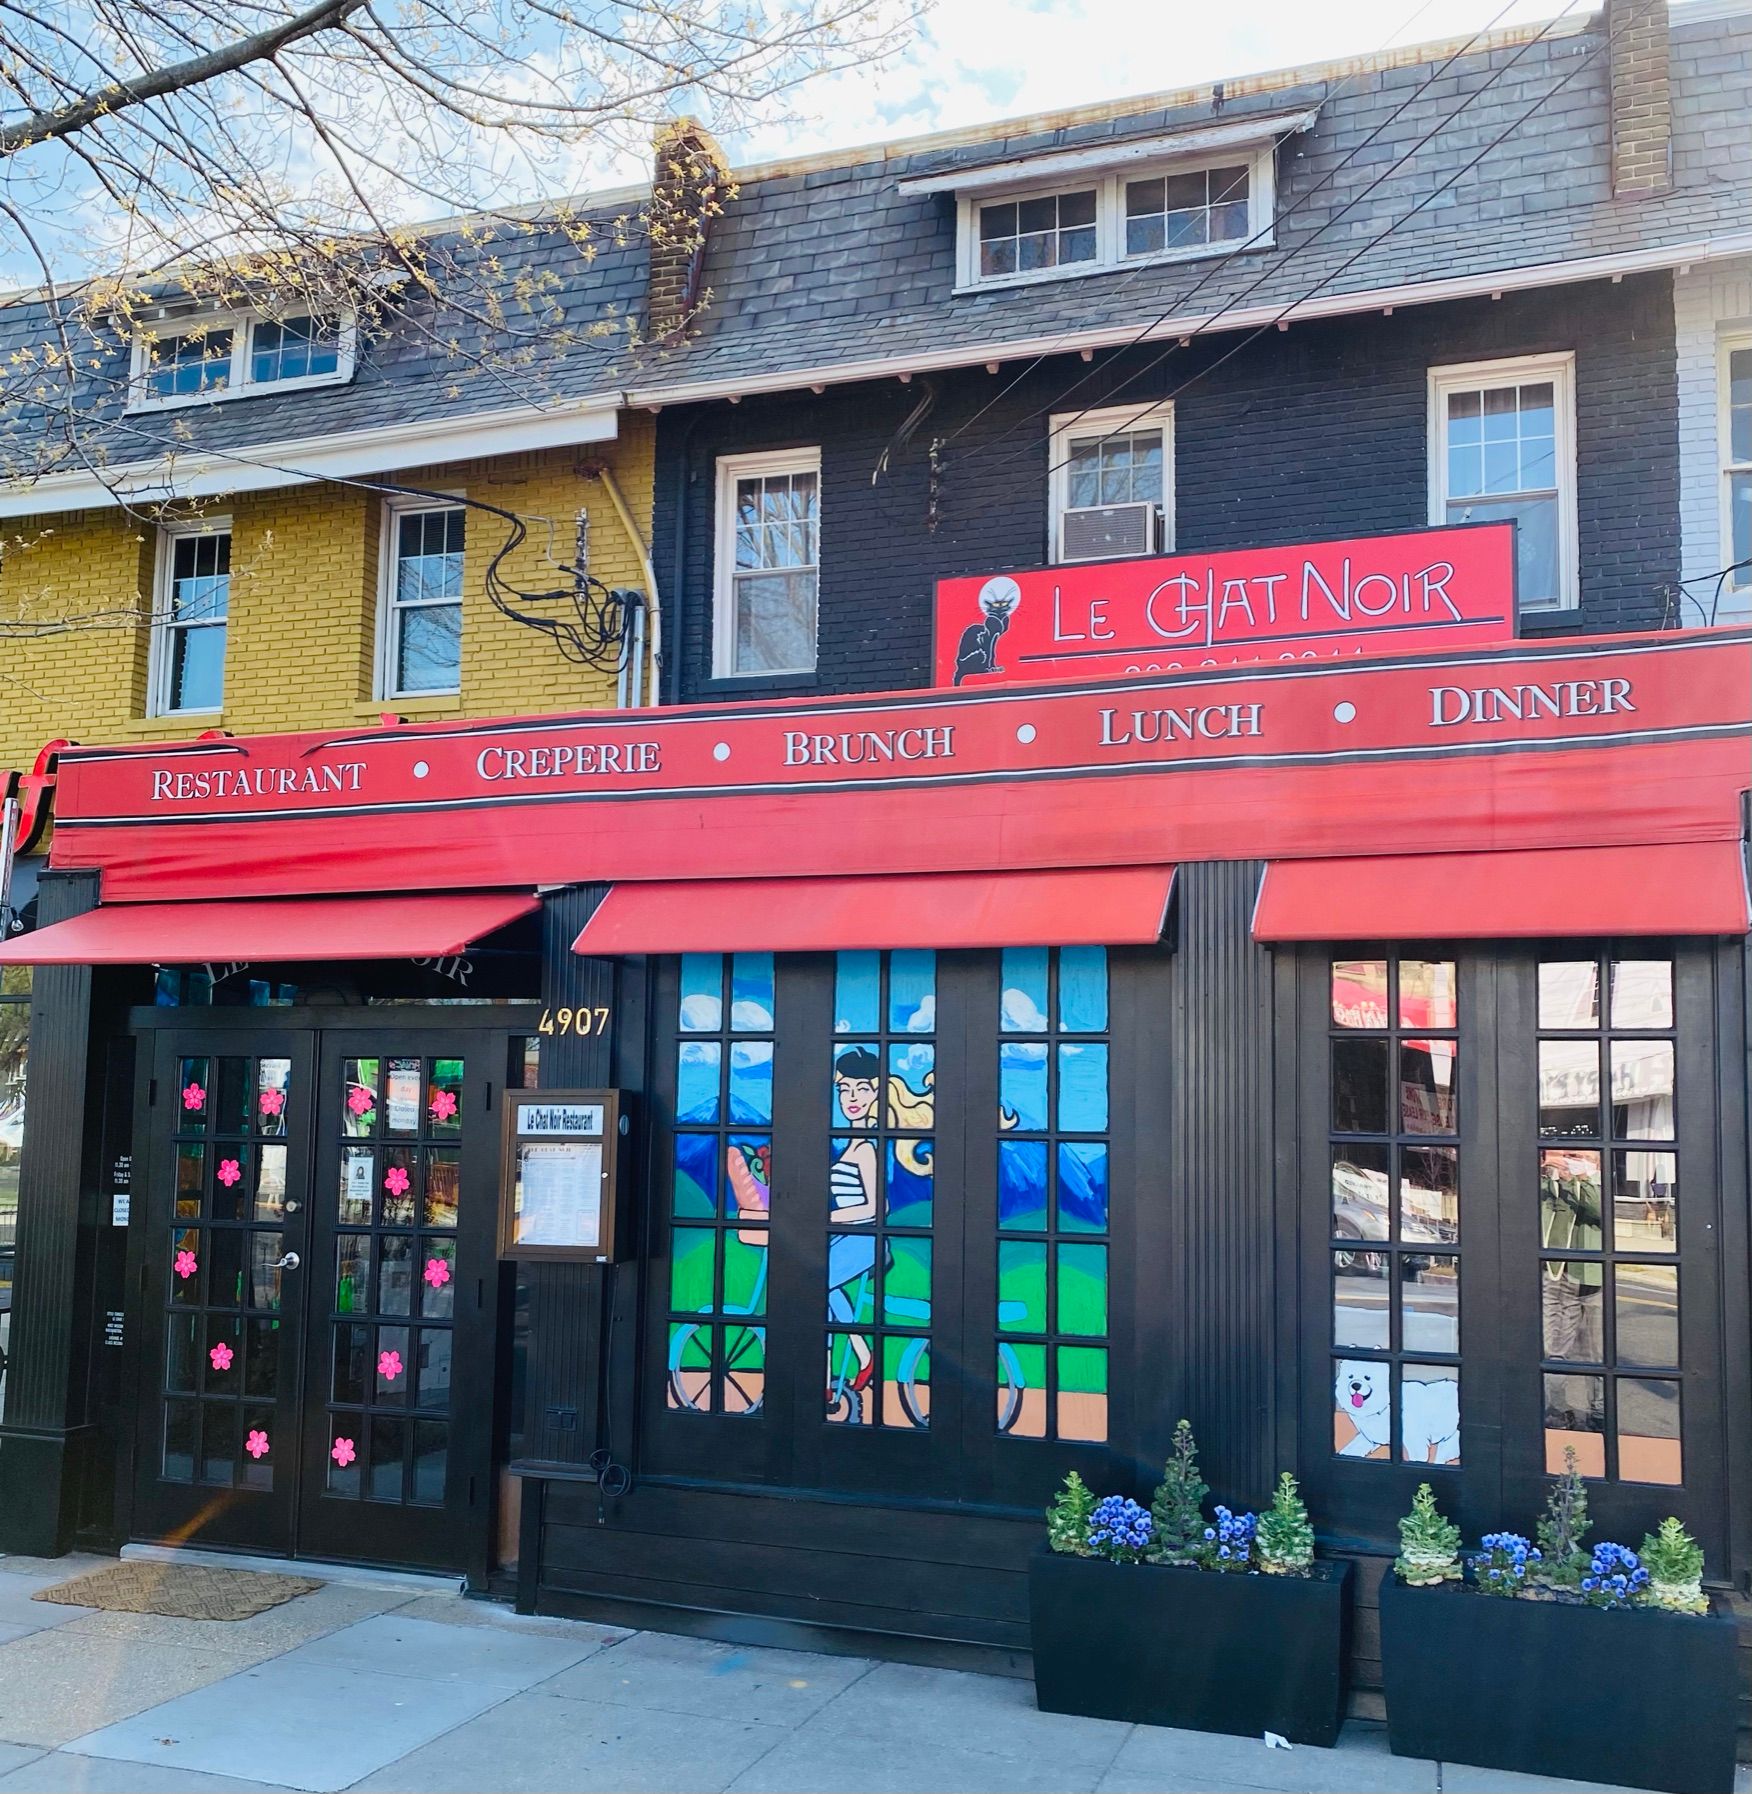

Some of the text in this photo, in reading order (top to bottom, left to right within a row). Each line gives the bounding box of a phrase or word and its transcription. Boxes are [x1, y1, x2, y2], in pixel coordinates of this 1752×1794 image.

[1053, 557, 1463, 648] LE CHAT NOIR
[150, 676, 1637, 801] RESTAURANT CREPERIE BRUNCH LUNCH DINNER
[538, 1007, 610, 1036] 4907
[536, 1108, 549, 1130] Chat
[549, 1108, 562, 1130] Noir
[562, 1108, 593, 1130] Restaurant
